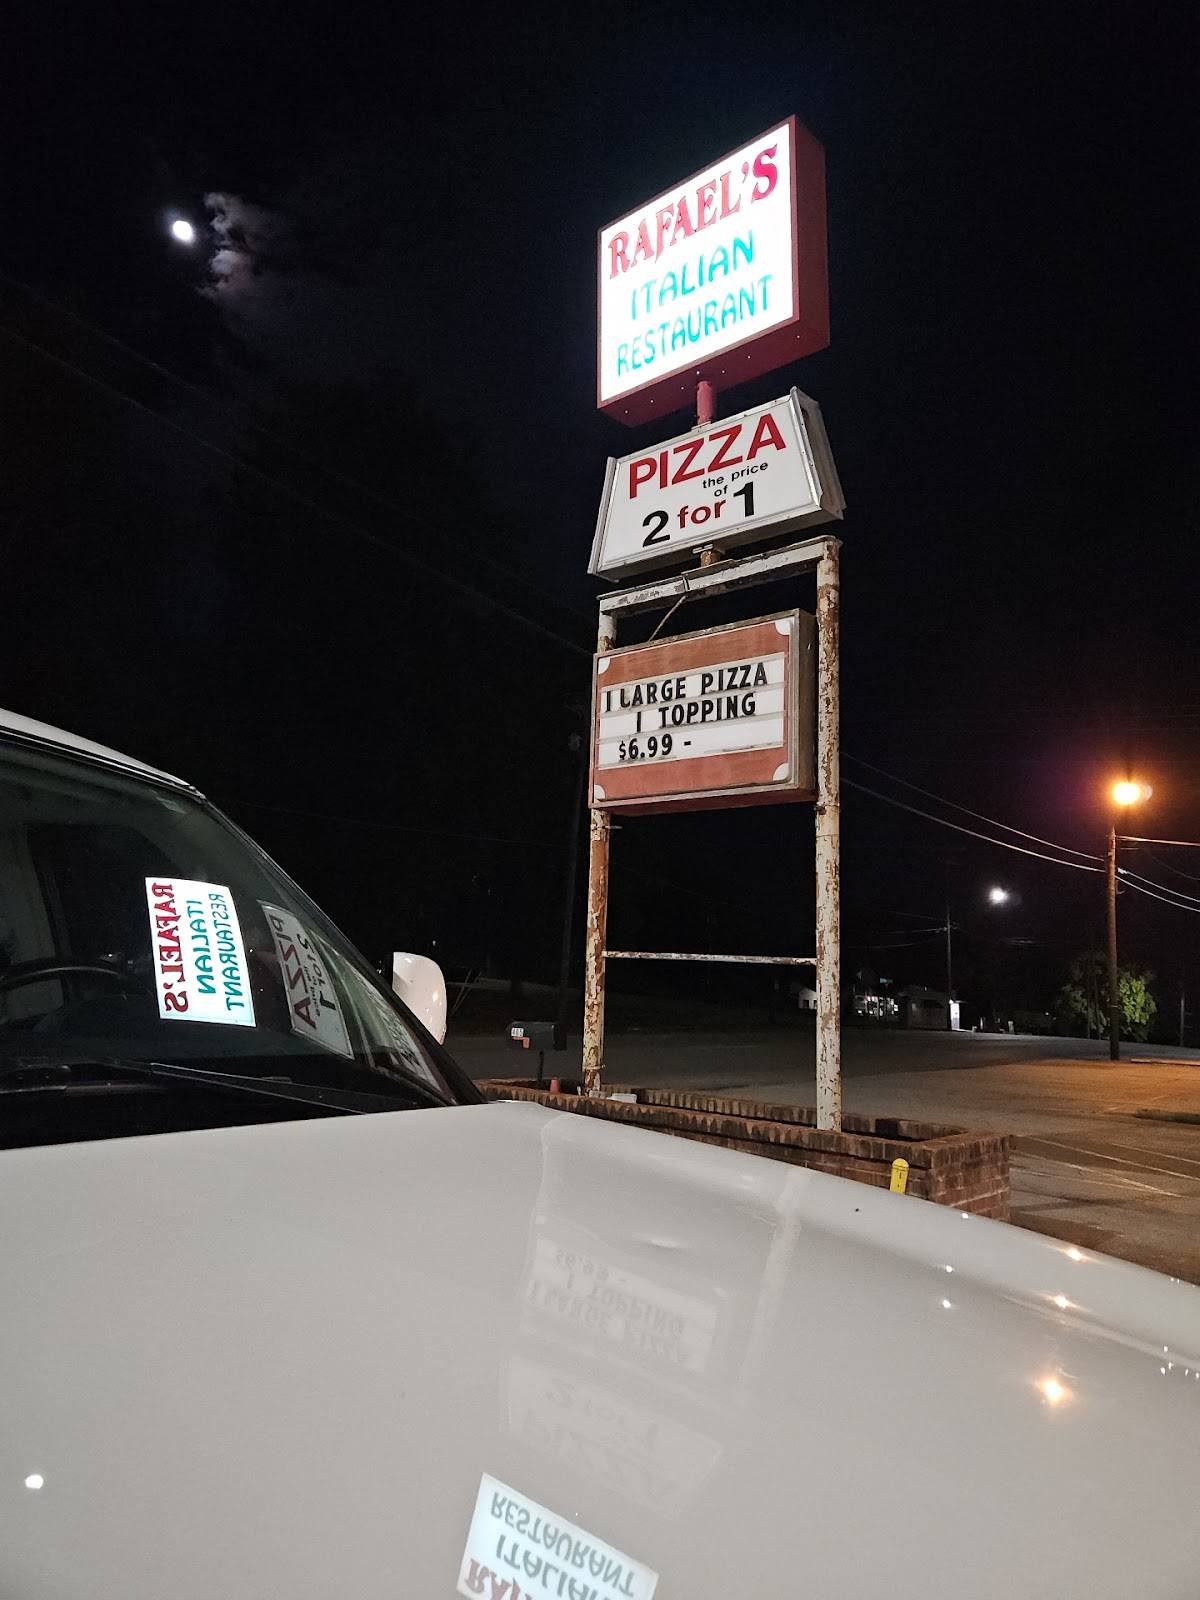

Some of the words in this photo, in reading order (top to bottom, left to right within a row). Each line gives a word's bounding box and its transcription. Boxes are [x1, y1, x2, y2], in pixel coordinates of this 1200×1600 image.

[609, 143, 779, 280] RAFAEL'S
[631, 230, 754, 320] ITALIAN
[616, 274, 774, 376] RESTAURANT
[629, 413, 787, 500] PIZZA
[702, 476, 724, 489] the
[731, 461, 769, 482] price
[642, 510, 671, 548] 2
[677, 500, 727, 529] for
[733, 481, 755, 518] 1
[713, 484, 728, 497] of
[620, 677, 686, 708] LARGE
[701, 662, 768, 695] PIZZA
[658, 692, 756, 729] TOPPING
[619, 733, 673, 760] $6.99
